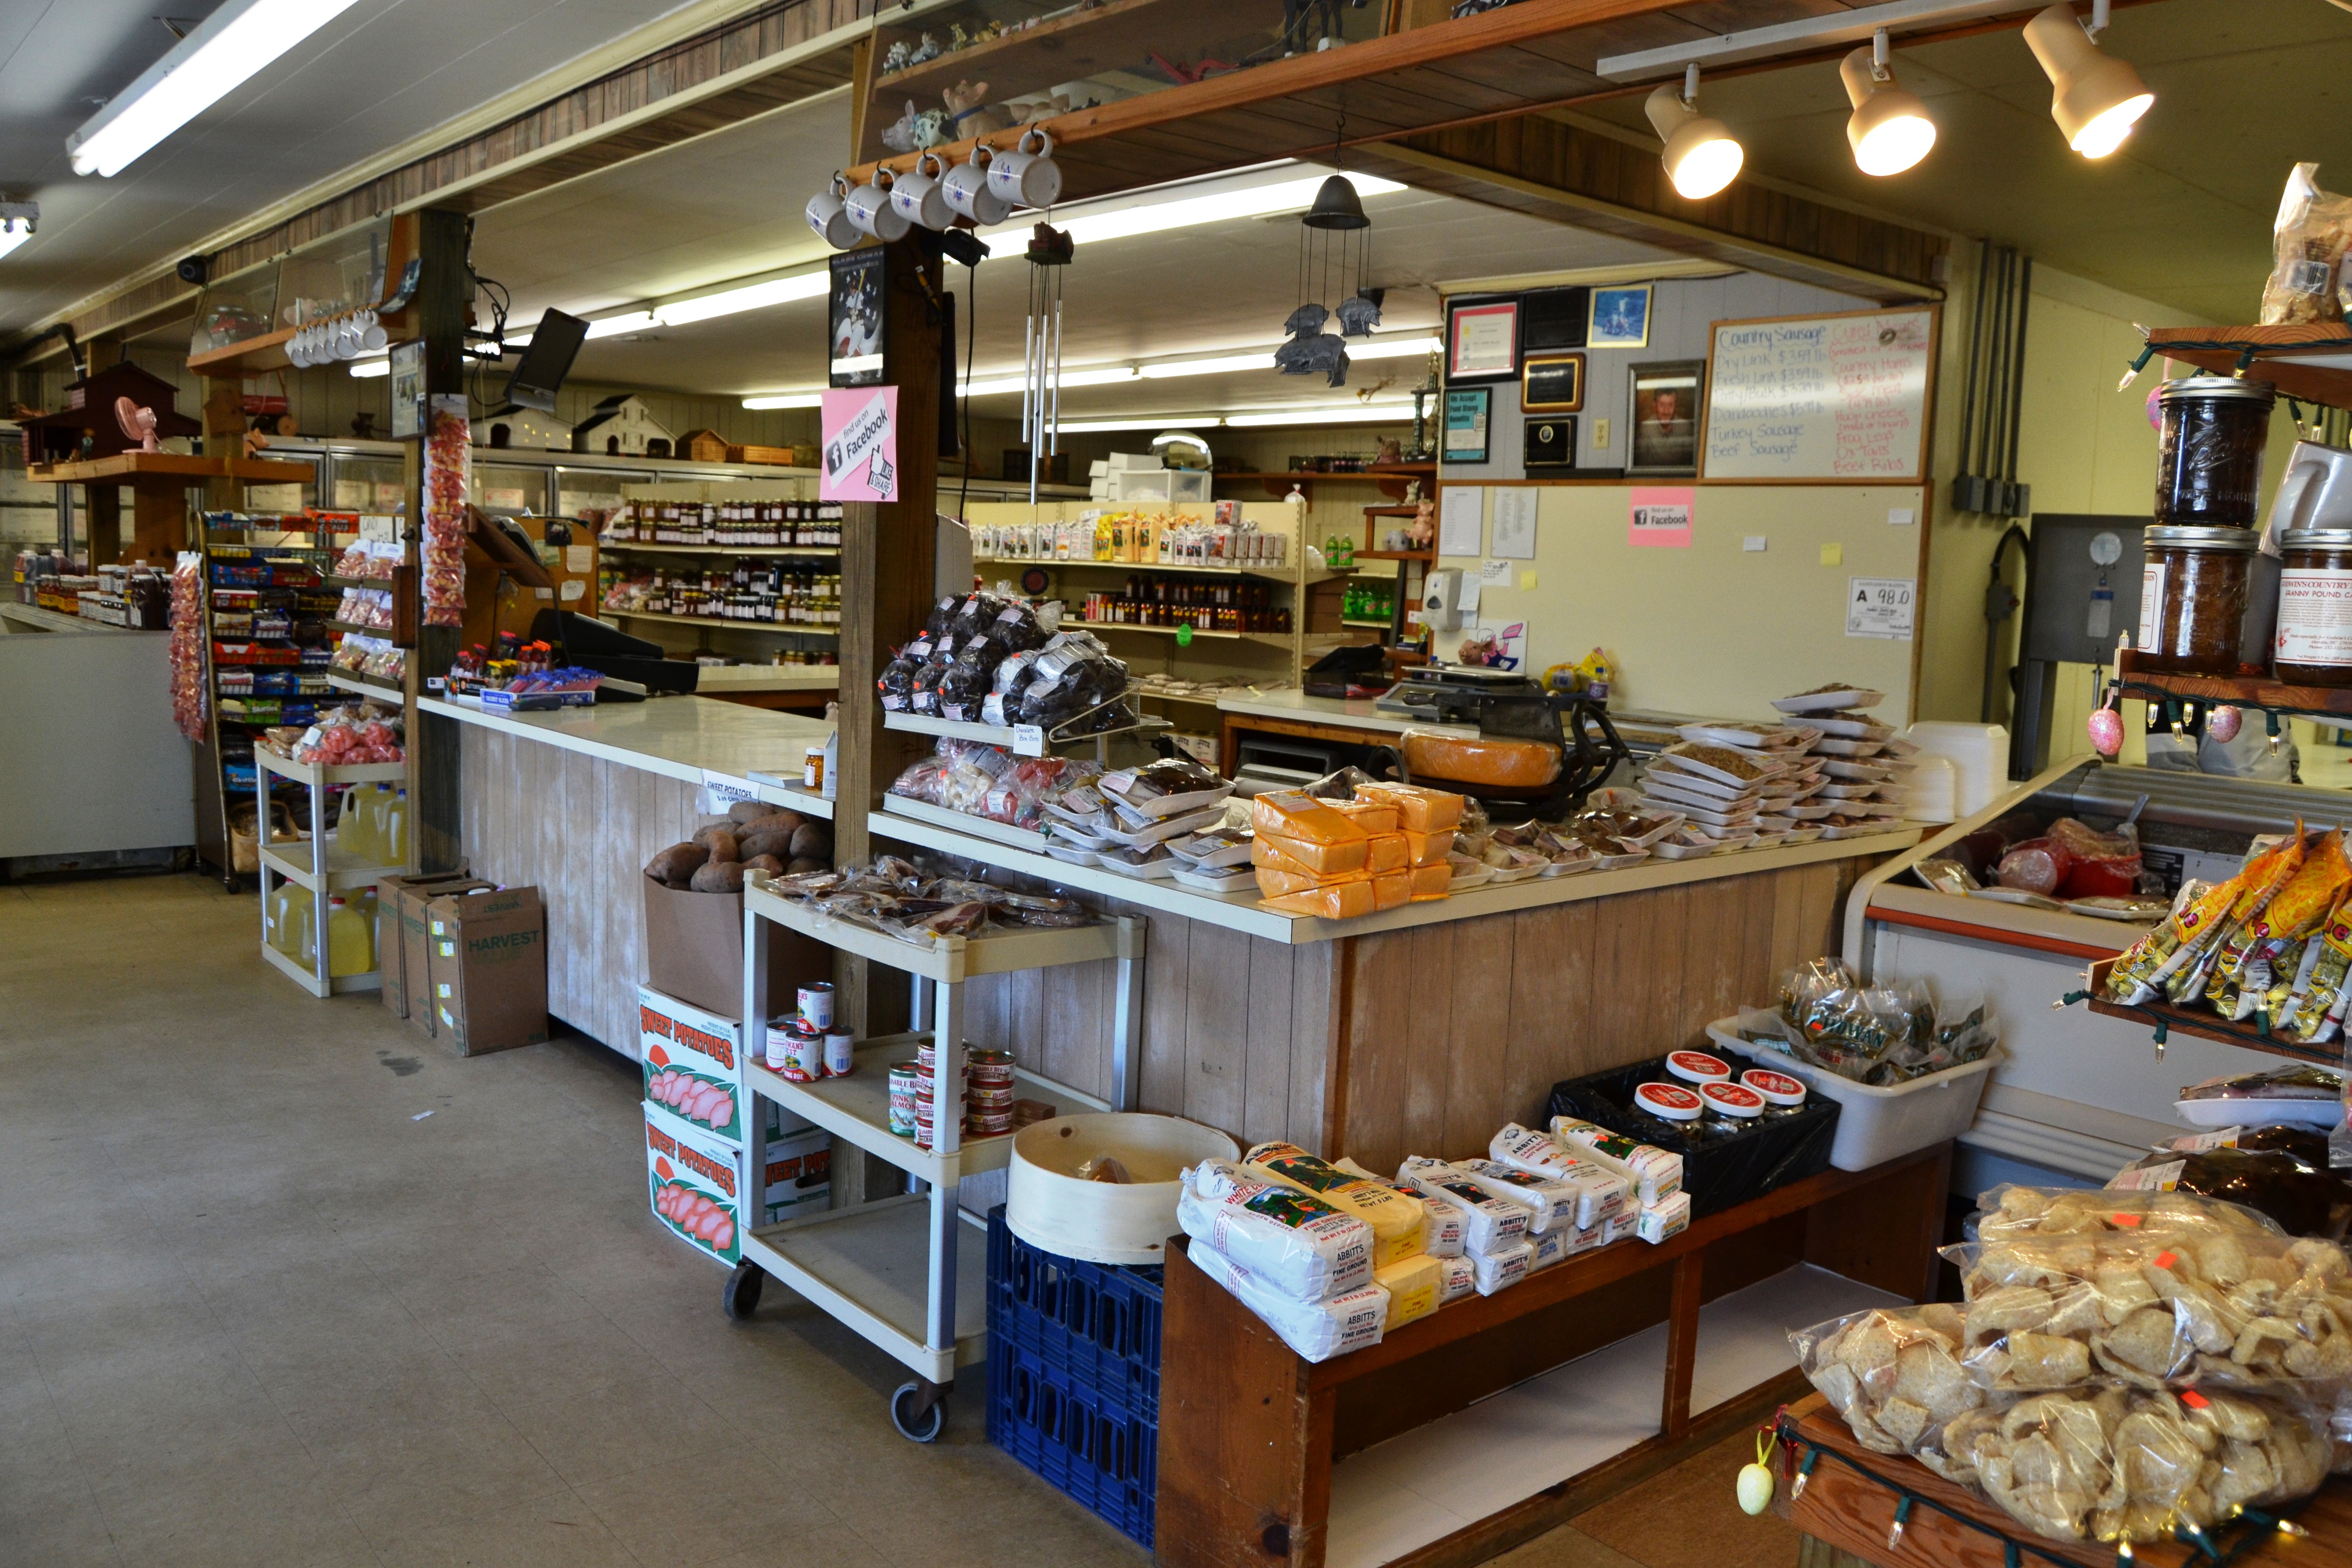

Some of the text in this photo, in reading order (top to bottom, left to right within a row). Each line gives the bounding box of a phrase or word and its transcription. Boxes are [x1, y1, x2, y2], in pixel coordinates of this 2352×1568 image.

[1720, 326, 1826, 352] Country Sausage
[843, 410, 869, 439] find us on
[846, 408, 888, 459] Facebook
[1710, 424, 1804, 444] Turkey Sausage
[1711, 442, 1797, 461] Beef Sausage
[882, 461, 893, 478] LIKE
[874, 477, 891, 493] SHARE
[1652, 514, 1687, 525] Facebook
[1857, 590, 1867, 602] A
[707, 781, 724, 792] SWEET
[724, 786, 752, 798] POTATOES
[469, 929, 540, 953] HARVEST
[640, 1004, 735, 1070] SWEET POTATOES
[893, 1094, 909, 1102] PINK
[983, 1116, 1003, 1124] BUMBLE
[1520, 1144, 1536, 1157] CAJUN
[1525, 1151, 1536, 1160] HOT
[647, 1120, 736, 1198] SWEET POTATOES
[1225, 1186, 1251, 1205] WHITE
[1604, 1190, 1620, 1201] ABBITT'S
[1304, 1213, 1350, 1231] FINE GROUND
[1313, 1220, 1339, 1233] ABBITT'S
[1500, 1216, 1527, 1227] ABBITT'S
[1614, 1212, 1635, 1225] ABBITT'S
[1537, 1234, 1558, 1247] ABBITT'S
[1337, 1244, 1364, 1263] ABBITT'S
[1333, 1258, 1367, 1277] FINE GROUND
[1503, 1255, 1529, 1269] ABBITT'S
[1348, 1310, 1376, 1326] ABBITT'S
[1341, 1325, 1378, 1339] FINE GROUND
